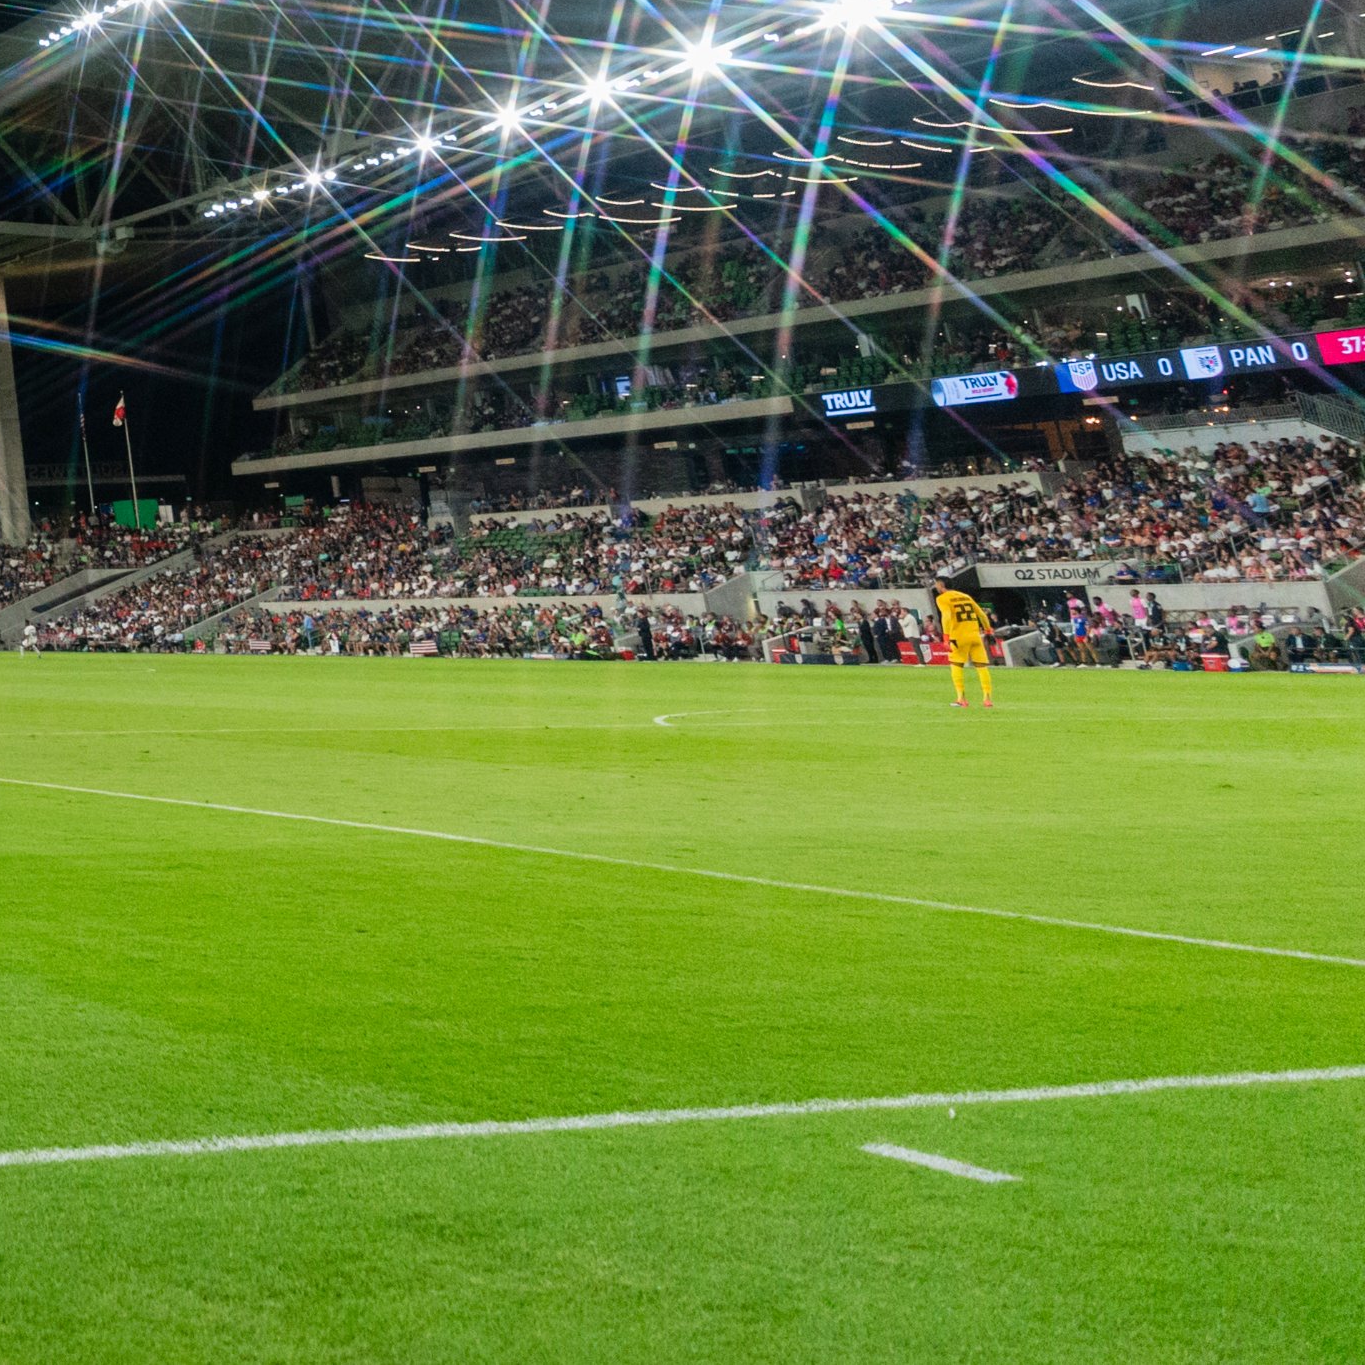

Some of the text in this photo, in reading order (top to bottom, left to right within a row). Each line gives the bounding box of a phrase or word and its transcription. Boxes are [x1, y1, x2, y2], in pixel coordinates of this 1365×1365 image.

[1230, 342, 1308, 367] PAN 0
[1101, 358, 1173, 381] USA 0
[959, 376, 999, 389] TRULY
[822, 390, 872, 410] TRULY
[1015, 568, 1100, 580] Q2 STADIUM
[954, 603, 978, 622] 22
